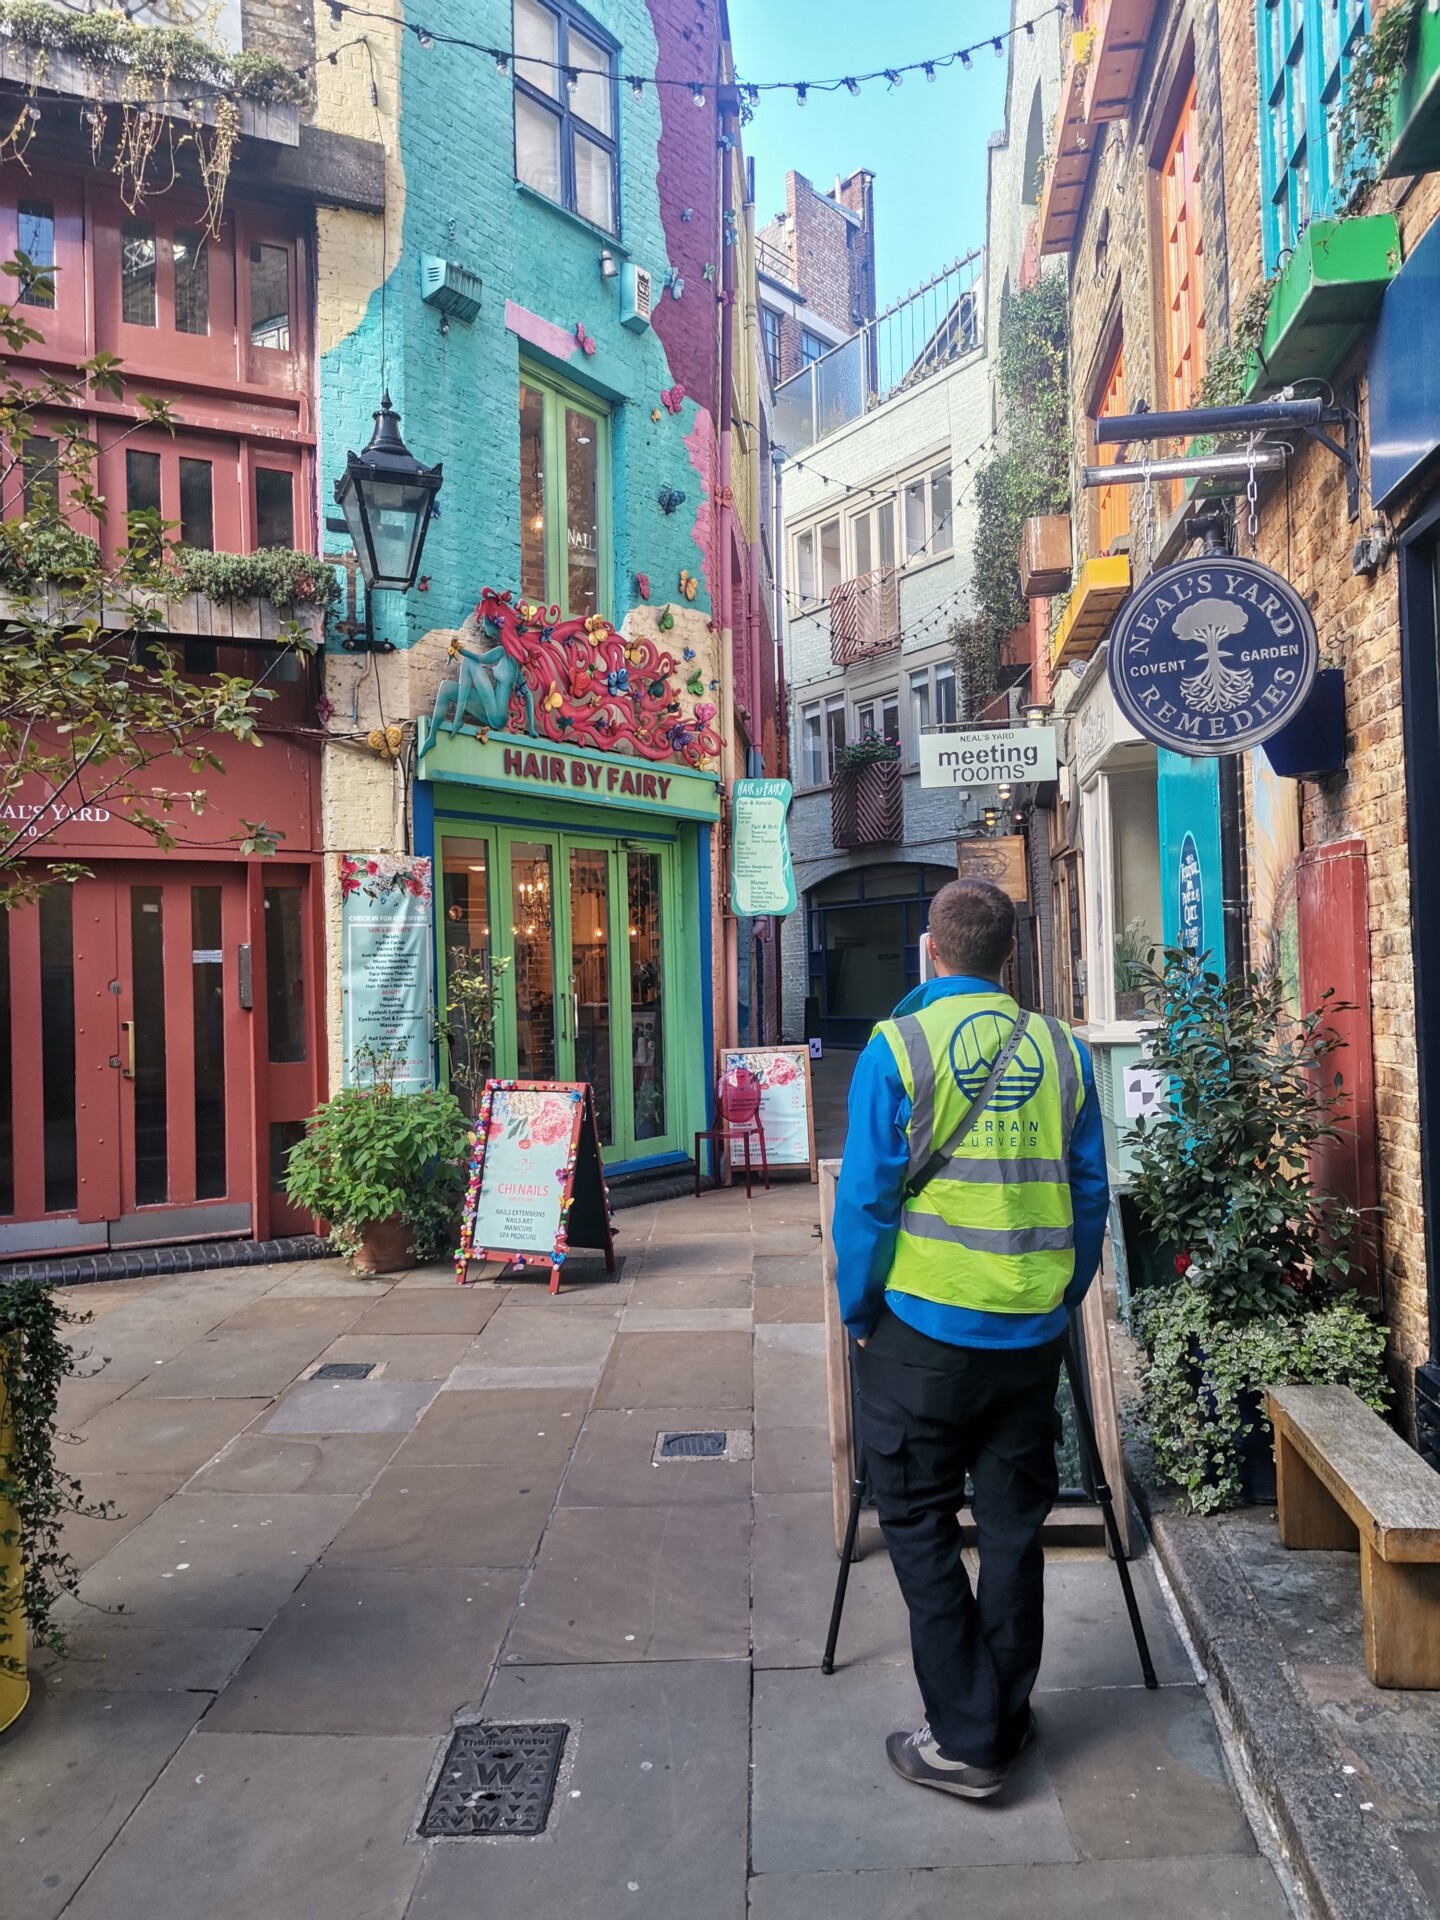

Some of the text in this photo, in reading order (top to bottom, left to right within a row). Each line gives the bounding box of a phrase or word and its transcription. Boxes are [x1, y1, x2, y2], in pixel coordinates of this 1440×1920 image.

[1129, 574, 1296, 657] NEAL'S YARD
[1130, 644, 1300, 678] COVENT GARDEN
[1138, 666, 1296, 737] REMEDIES
[960, 732, 1015, 742] NEAL'S YARD
[938, 743, 1038, 766] meeting
[504, 748, 672, 800] HAIR BY FAIRY
[953, 764, 1025, 782] rooms
[737, 781, 754, 796] HAIR
[763, 782, 786, 796] FAIRY
[0, 804, 110, 822] AL'S YARD
[970, 1120, 1039, 1132] ERRAIN
[497, 1183, 549, 1196] CHI NAILS
[512, 1209, 546, 1217] EXTENSIONS
[510, 1233, 537, 1241] PEDICURE
[462, 1738, 552, 1747] Thames Water
[476, 1762, 525, 1786] W
[471, 1813, 500, 1829] W
